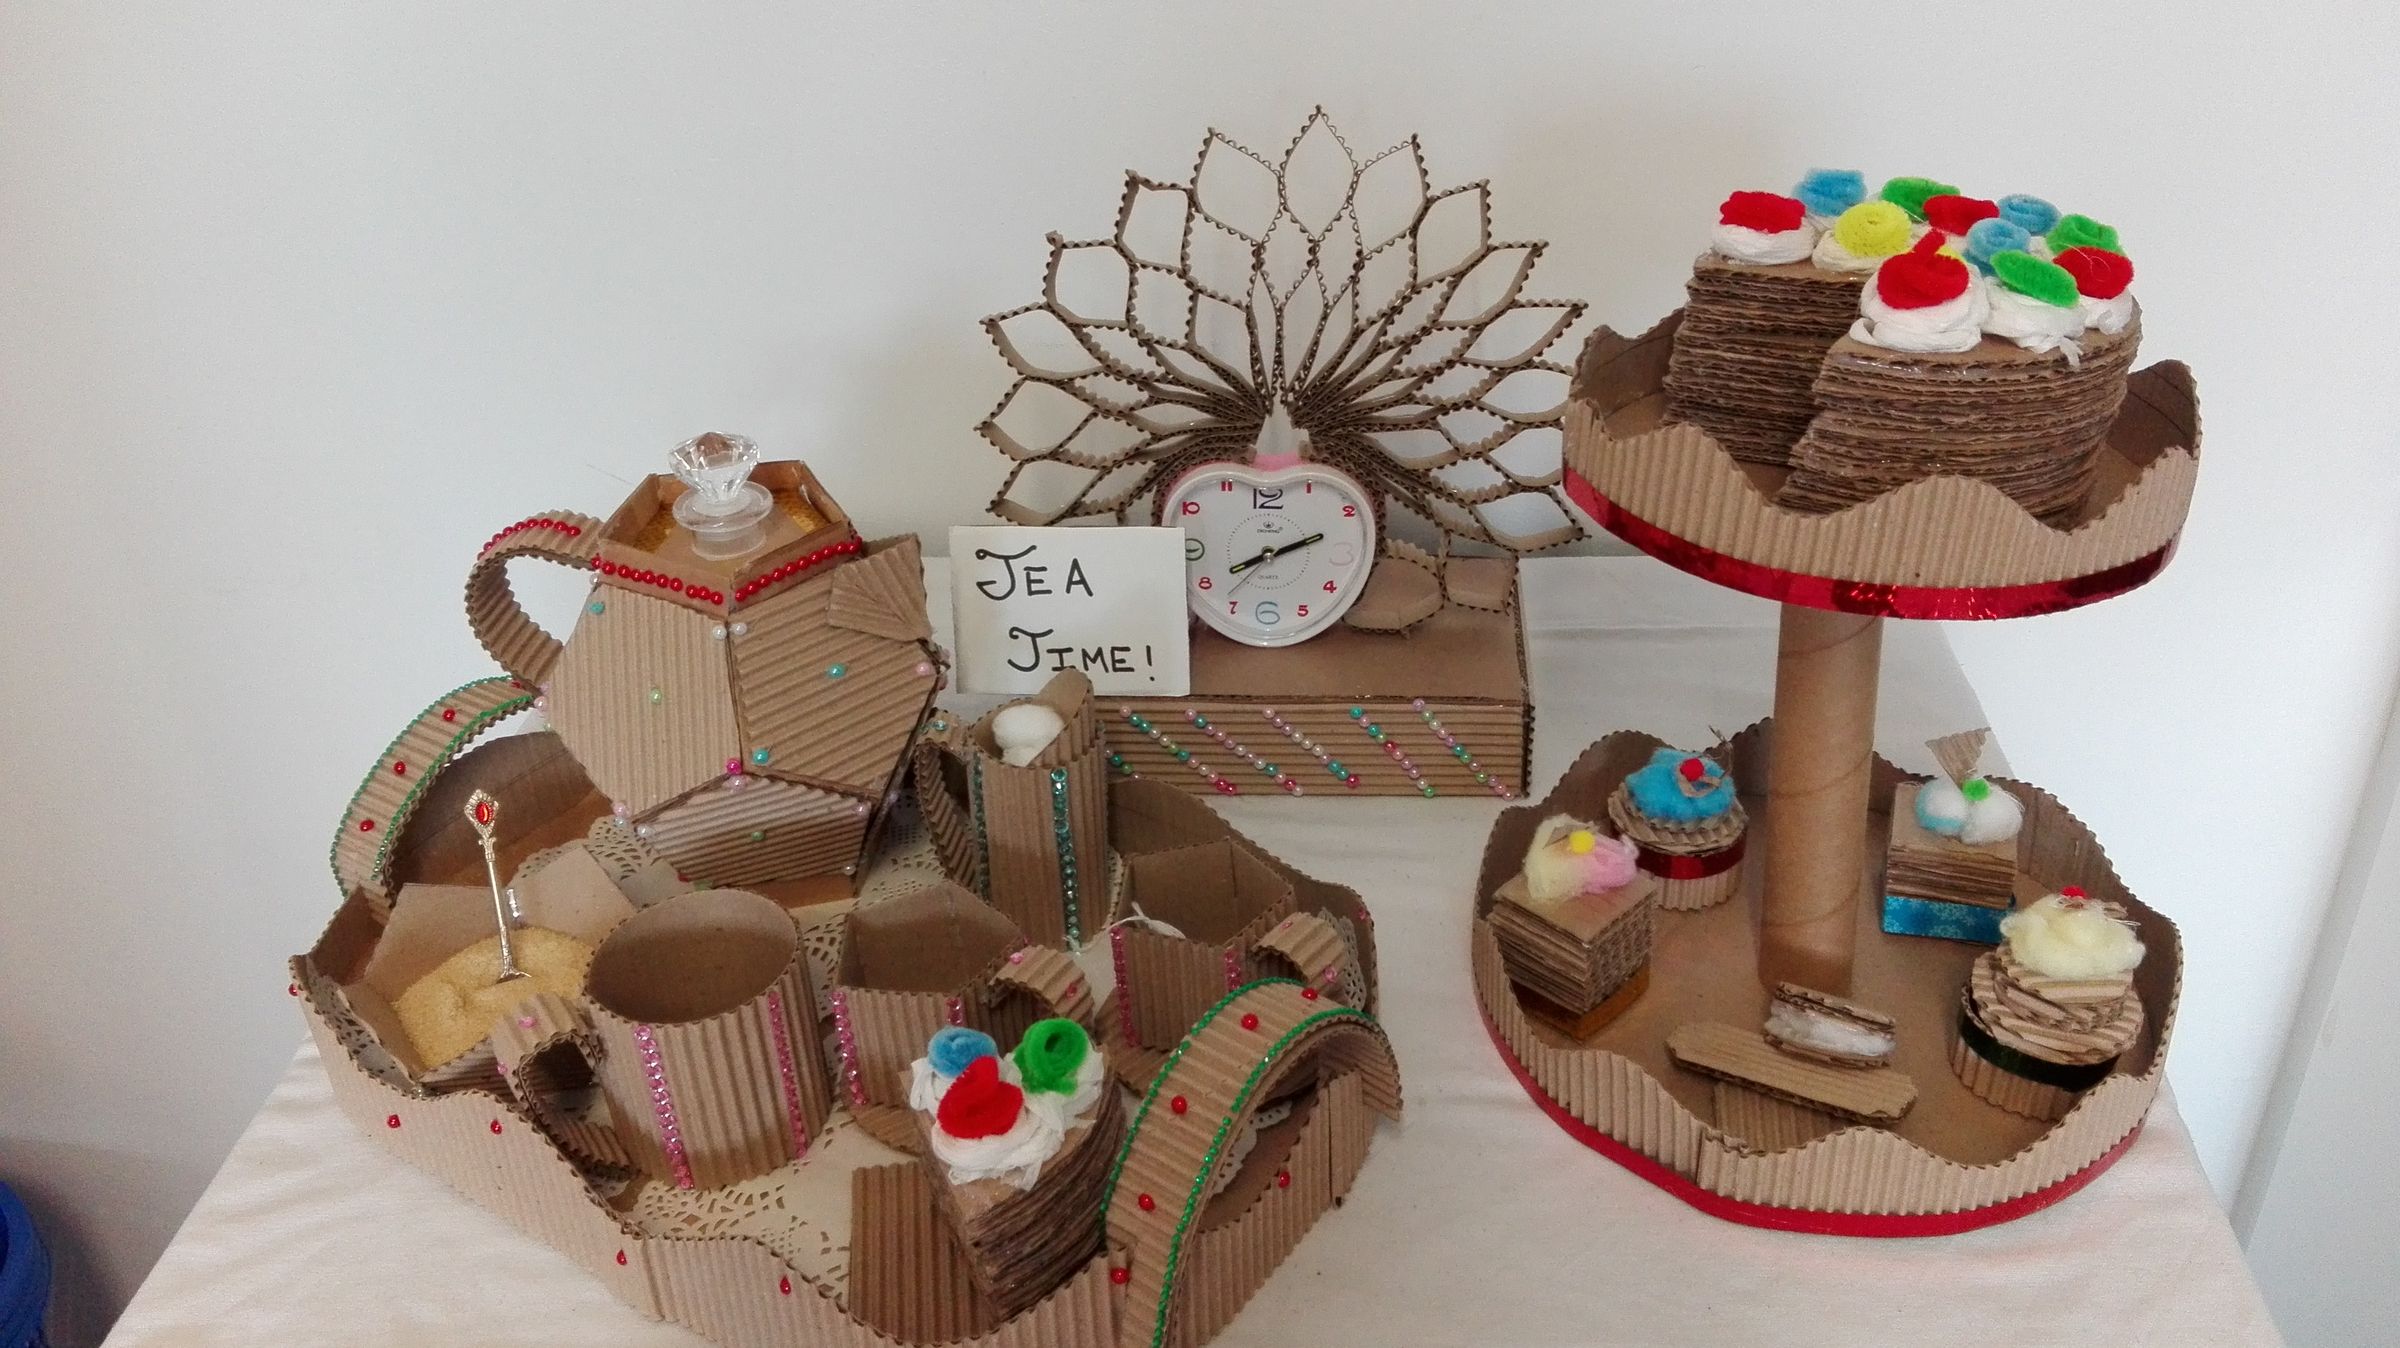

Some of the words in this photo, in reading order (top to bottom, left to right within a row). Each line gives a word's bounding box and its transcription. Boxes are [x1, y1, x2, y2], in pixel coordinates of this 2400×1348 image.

[1220, 481, 1233, 492] 11
[1253, 488, 1284, 510] 12
[1182, 501, 1200, 516] 10
[1342, 505, 1355, 517] 2
[1329, 541, 1354, 567] 3
[975, 545, 1093, 601] TEA
[1198, 577, 1212, 590] 8
[1323, 580, 1337, 594] 4
[1229, 601, 1238, 615] 7
[1255, 601, 1280, 625] 6
[1297, 605, 1309, 617] 5
